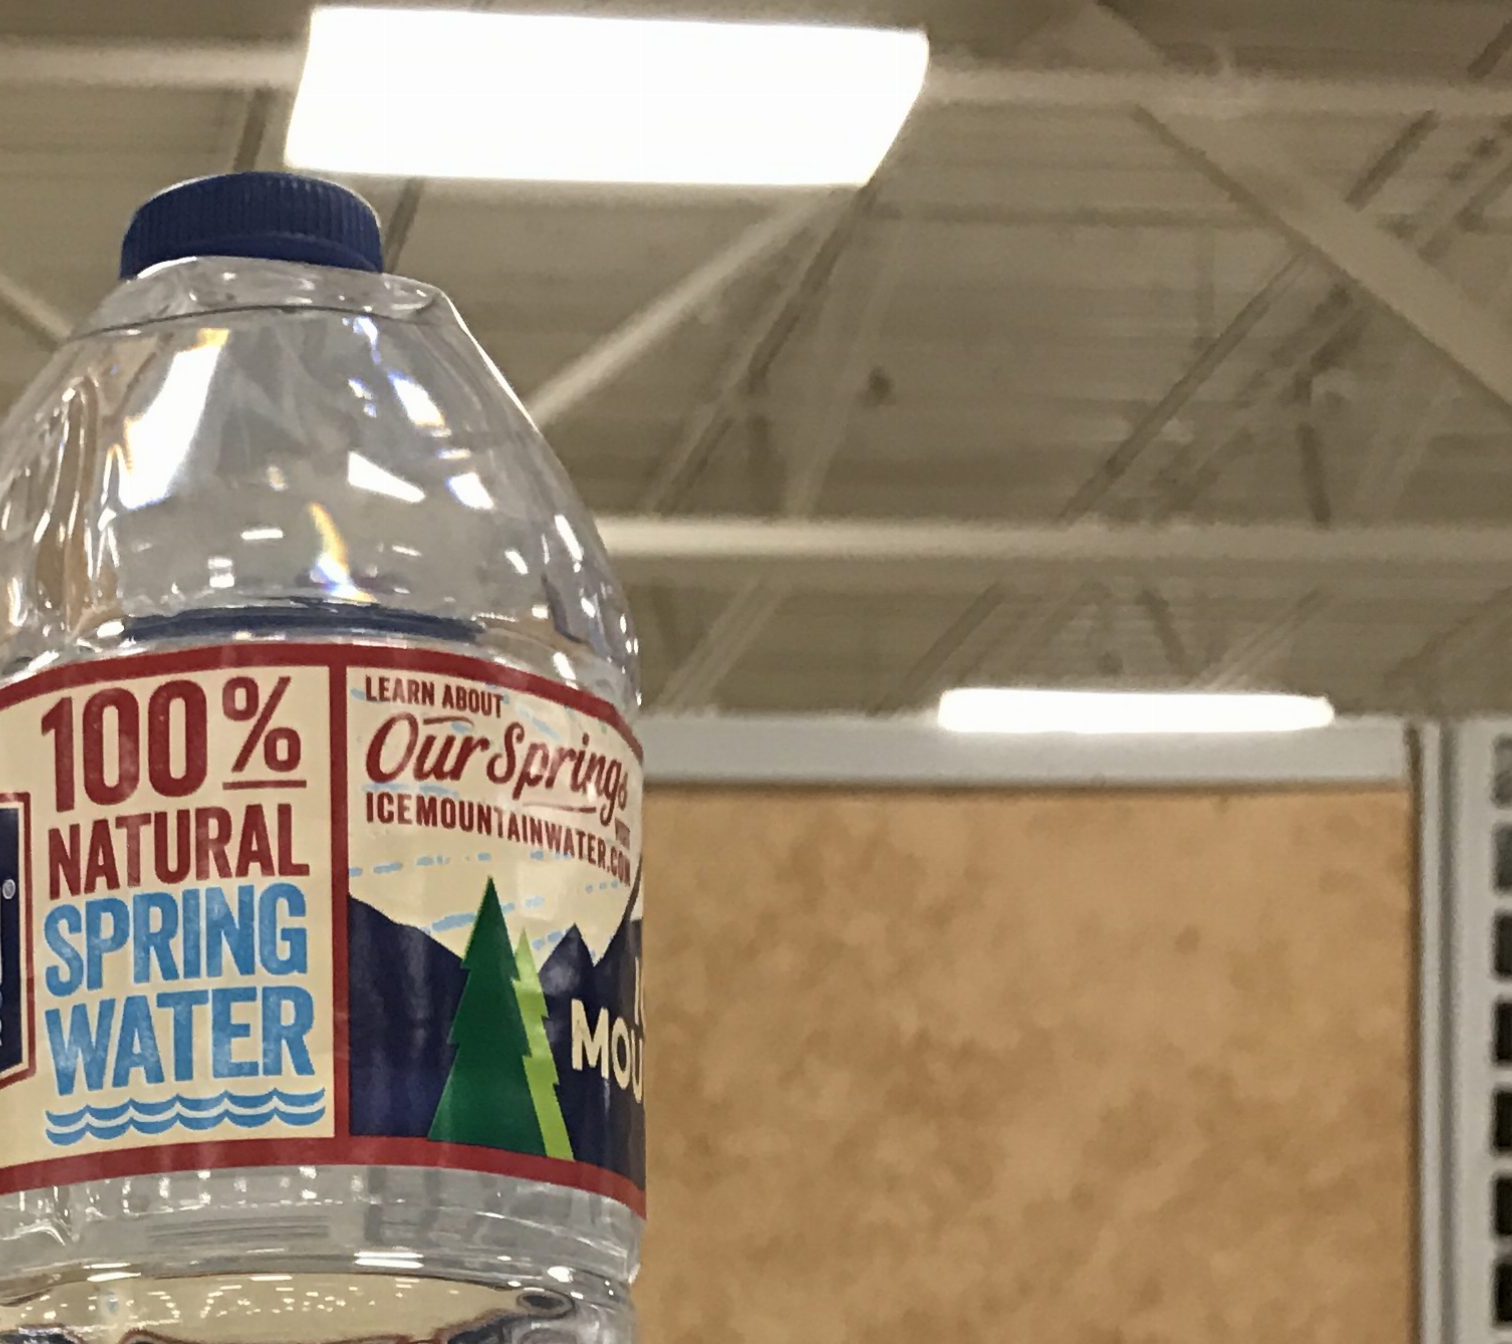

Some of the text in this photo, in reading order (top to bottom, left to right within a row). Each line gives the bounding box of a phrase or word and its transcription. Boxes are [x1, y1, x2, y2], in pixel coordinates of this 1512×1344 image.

[41, 676, 308, 812] 100%
[365, 675, 504, 718] LEARN ABOUT
[365, 712, 491, 784] Our
[48, 803, 310, 899] NATURAL
[43, 882, 309, 997] SPRING
[45, 987, 315, 1096] WATER
